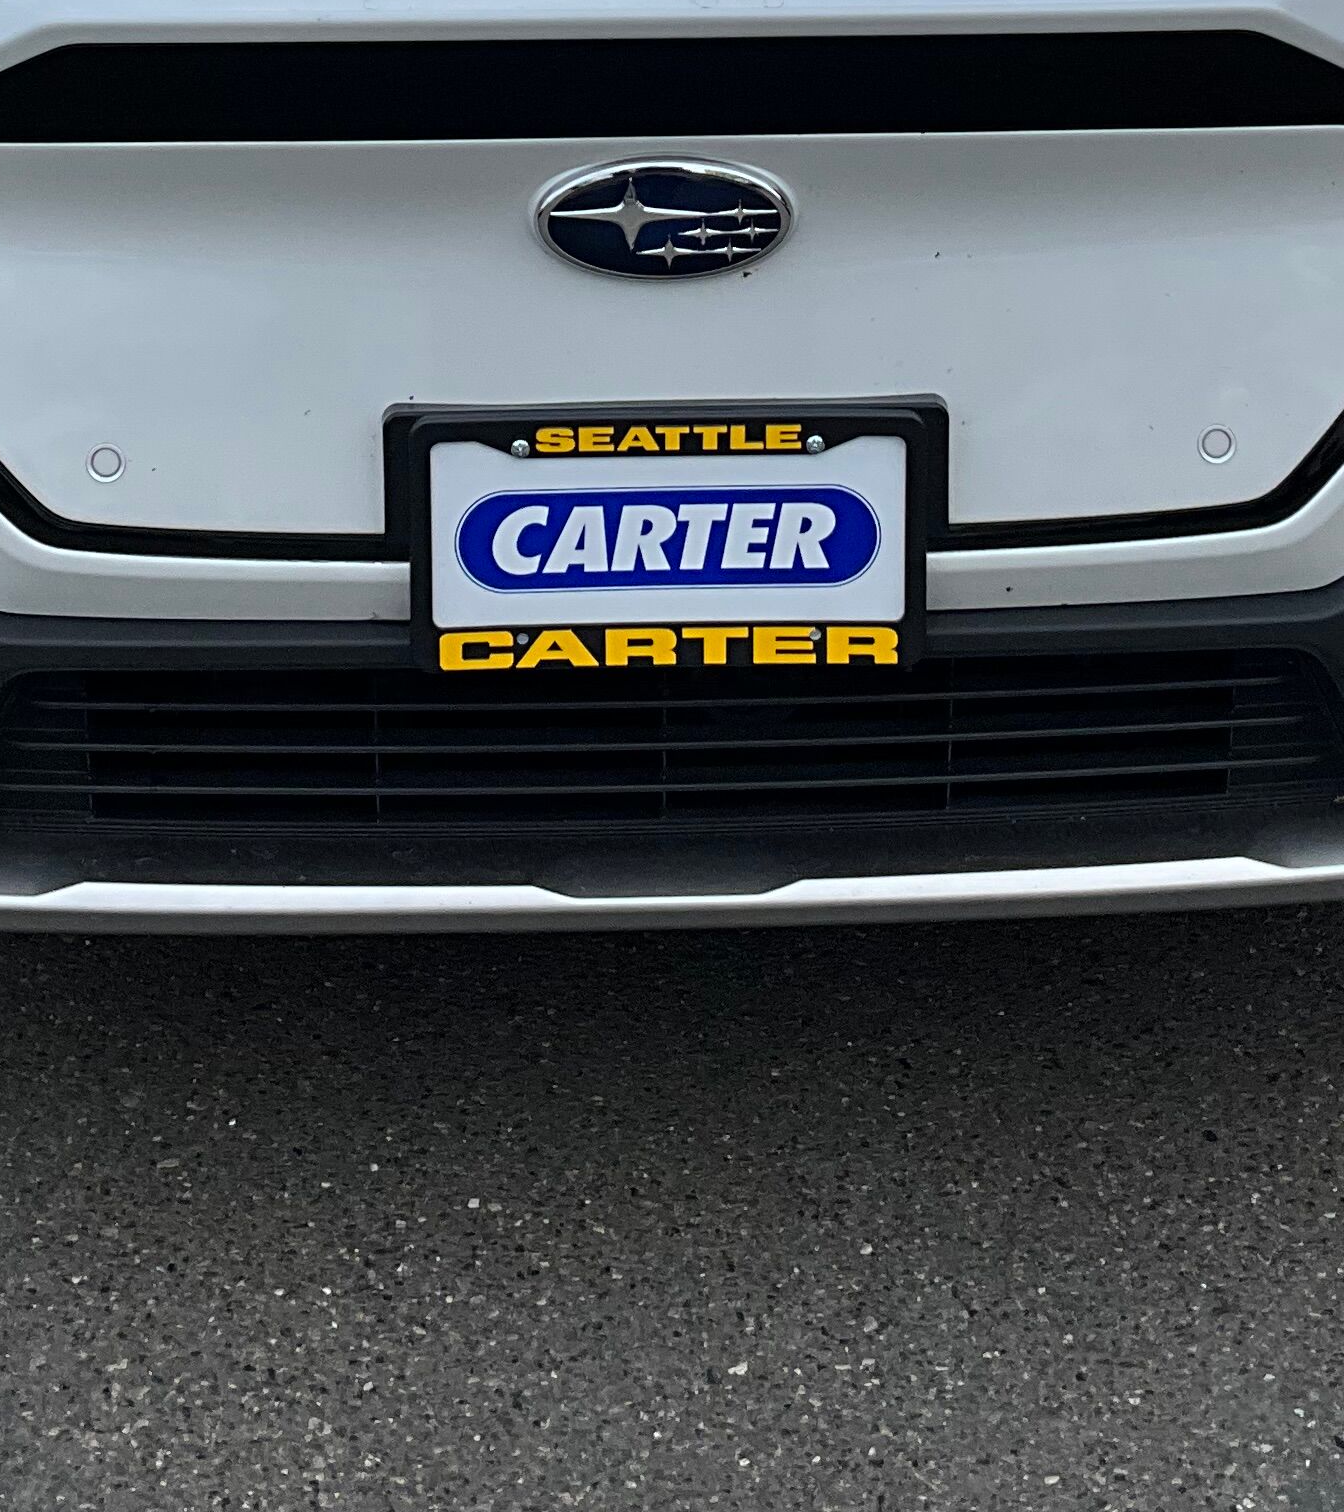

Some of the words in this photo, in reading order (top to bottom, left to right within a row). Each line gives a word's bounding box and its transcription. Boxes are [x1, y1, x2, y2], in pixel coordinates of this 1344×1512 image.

[535, 423, 802, 453] SEATTLE
[491, 501, 837, 576] CARTER
[438, 625, 898, 672] CARTER
